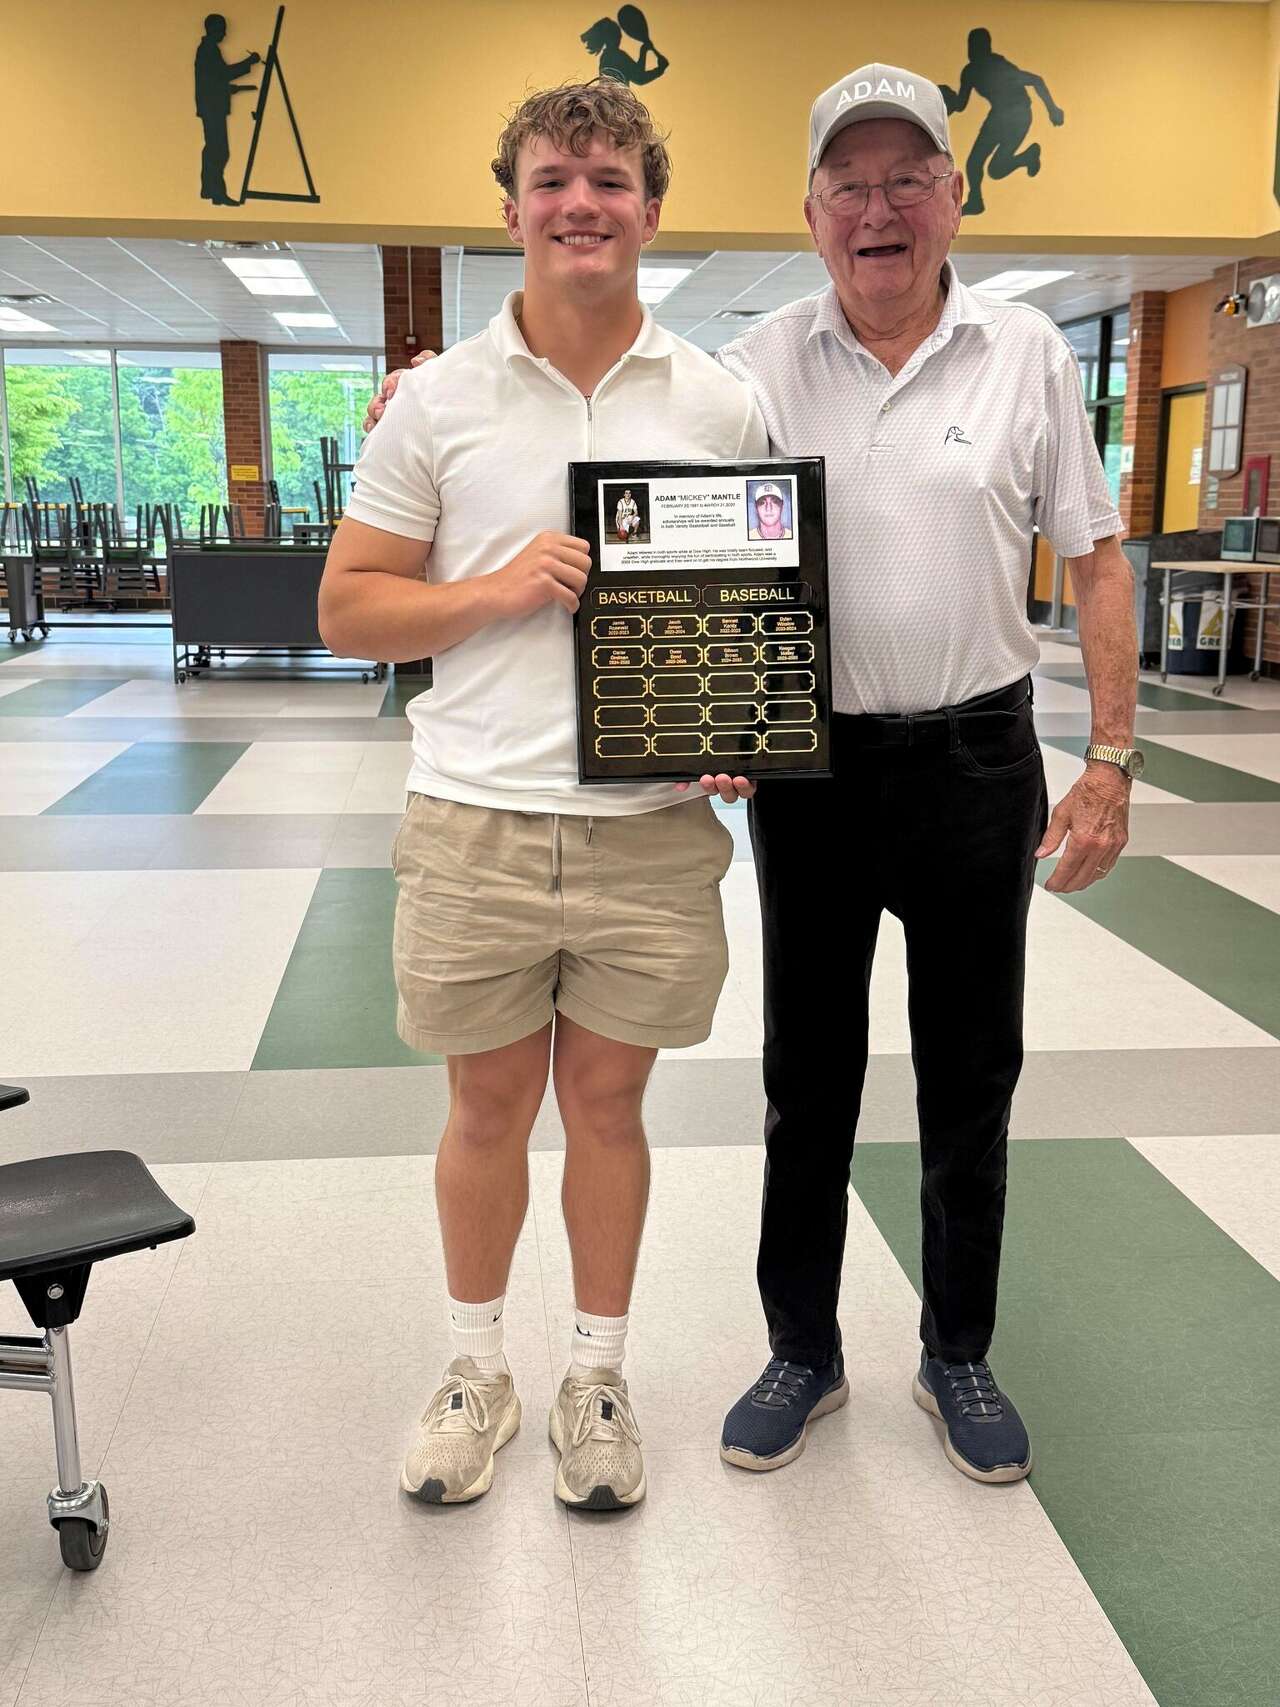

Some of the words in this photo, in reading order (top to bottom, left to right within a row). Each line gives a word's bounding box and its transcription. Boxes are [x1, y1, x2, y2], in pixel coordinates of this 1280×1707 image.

[835, 78, 915, 111] ADAM
[711, 493, 741, 501] MANTLE
[598, 590, 692, 605] BASKETBALL
[720, 588, 795, 602] BASEBALL
